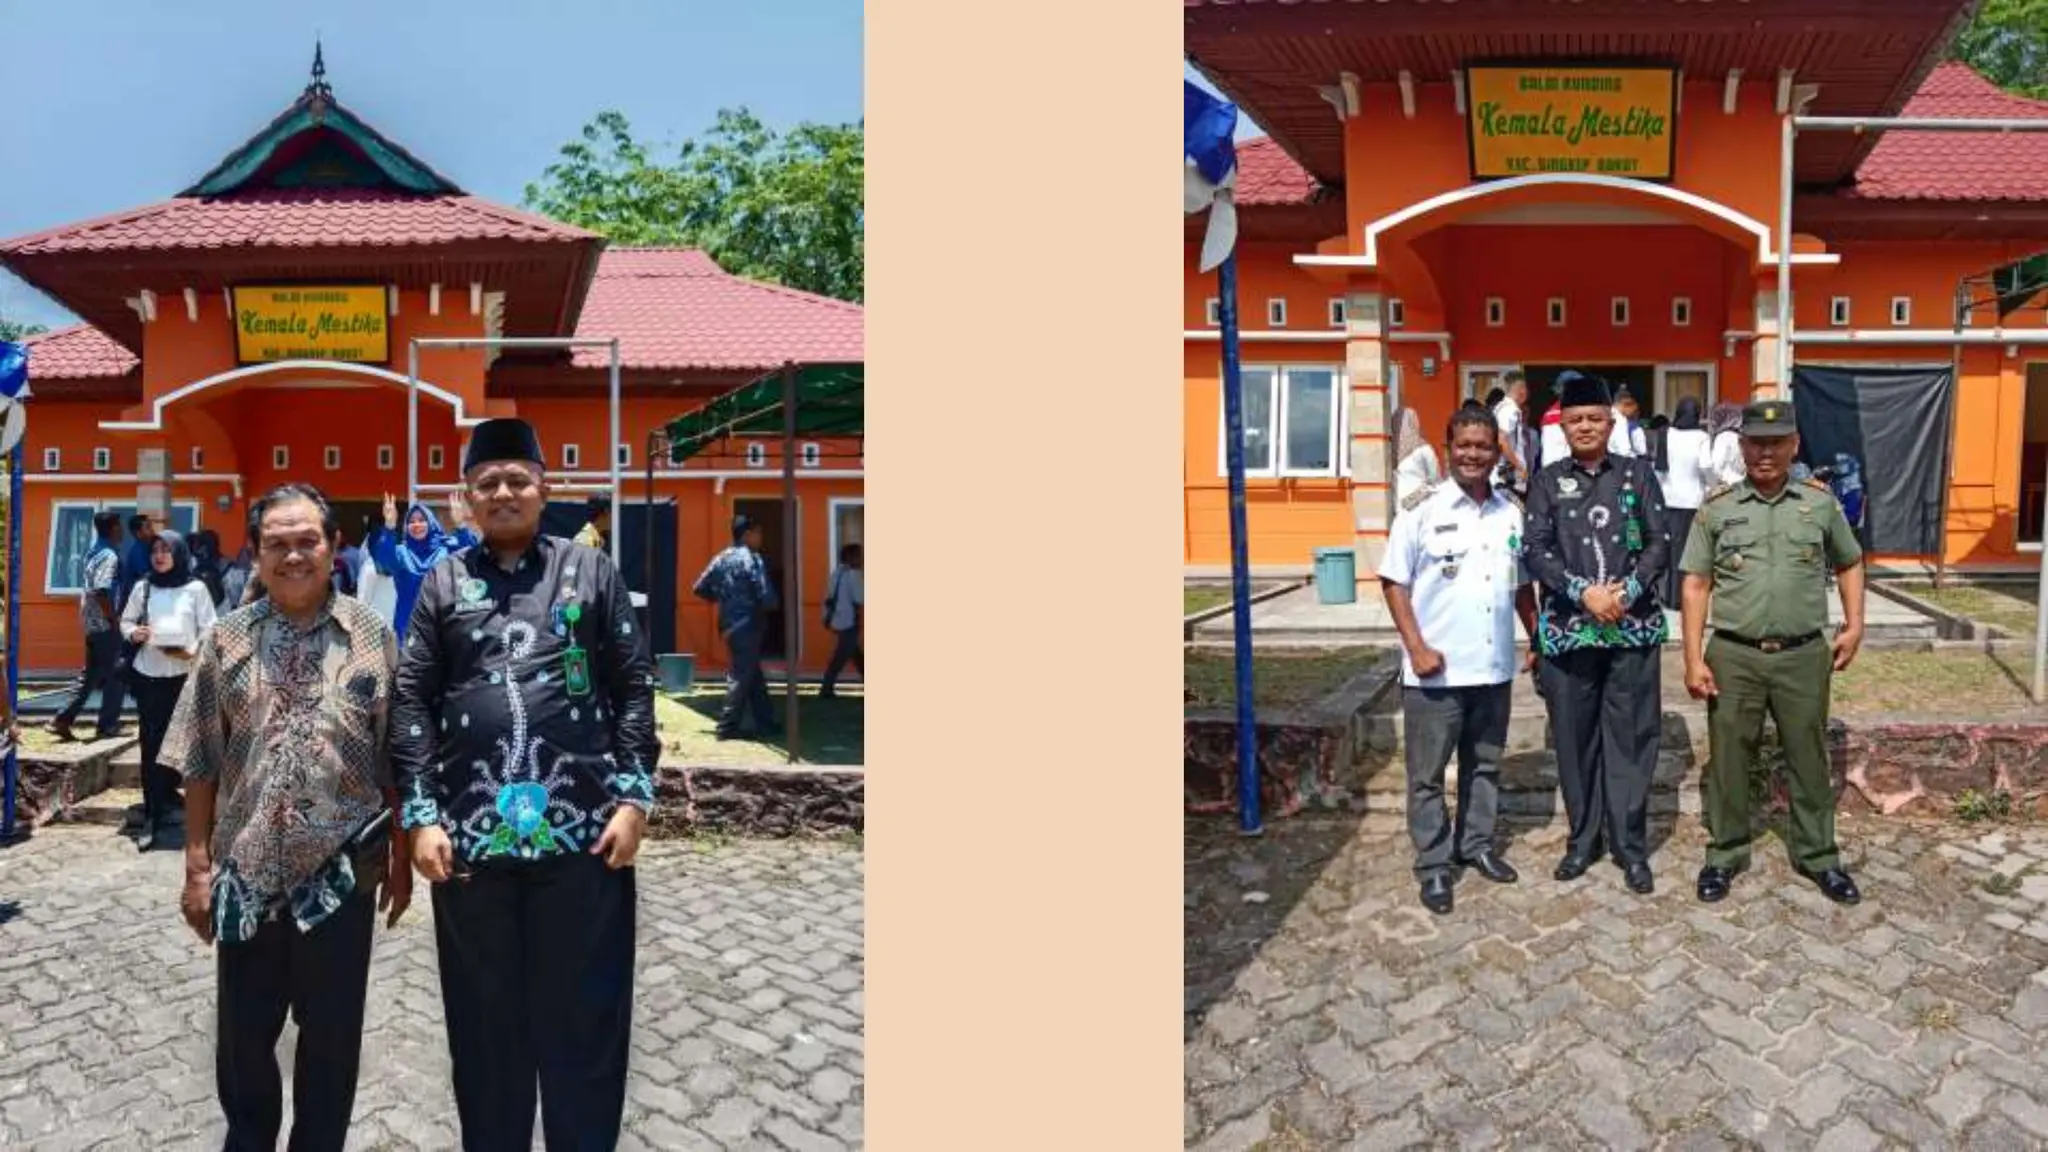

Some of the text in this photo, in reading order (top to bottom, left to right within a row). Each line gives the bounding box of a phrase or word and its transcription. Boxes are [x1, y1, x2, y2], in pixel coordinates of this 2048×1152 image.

[1478, 101, 1664, 145] Kemala Mestika
[241, 309, 381, 340] Kemala Mestika
